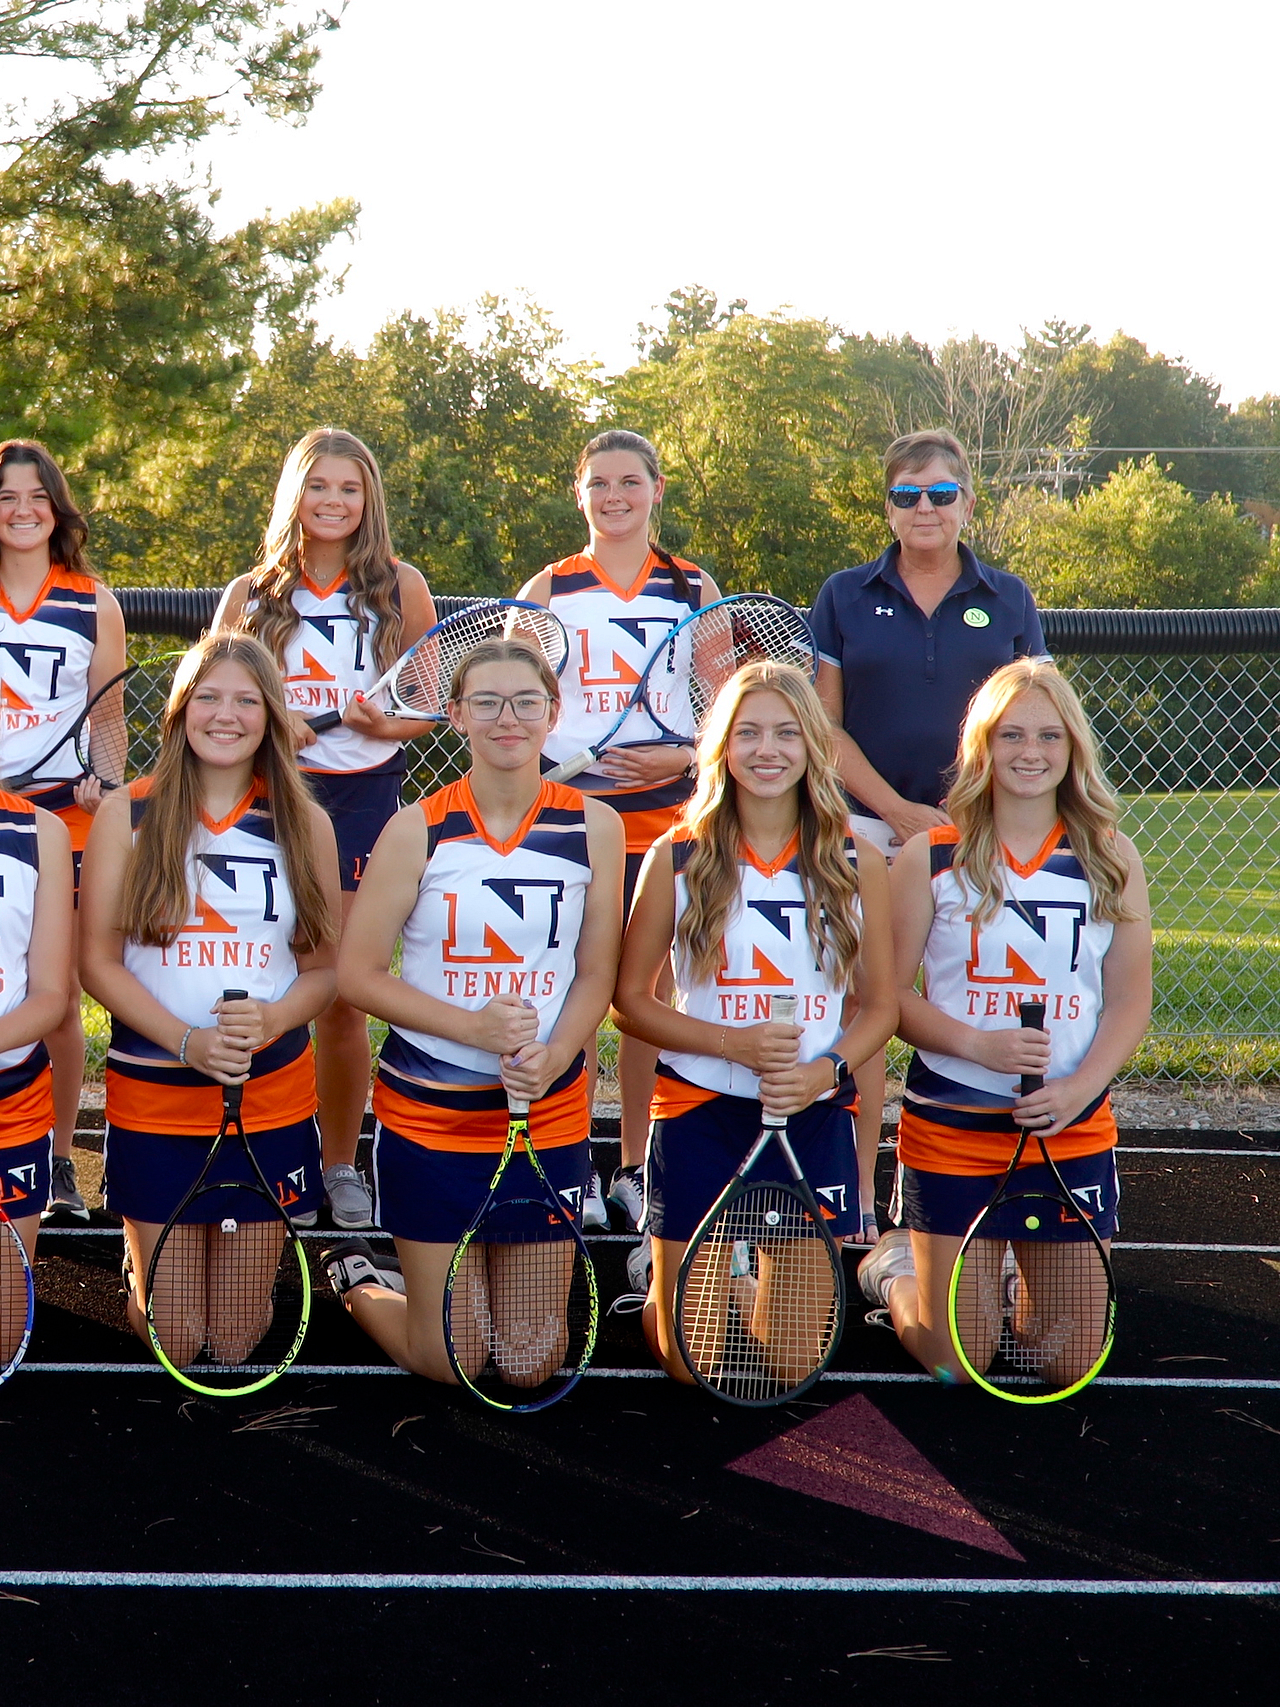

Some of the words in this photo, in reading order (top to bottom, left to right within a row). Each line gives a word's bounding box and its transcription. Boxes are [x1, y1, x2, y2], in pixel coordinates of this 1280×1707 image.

[439, 598, 501, 626] TITANIUM
[443, 969, 556, 998] TENNIS
[718, 993, 827, 1021] TENIS
[276, 1320, 307, 1375] HEAD
